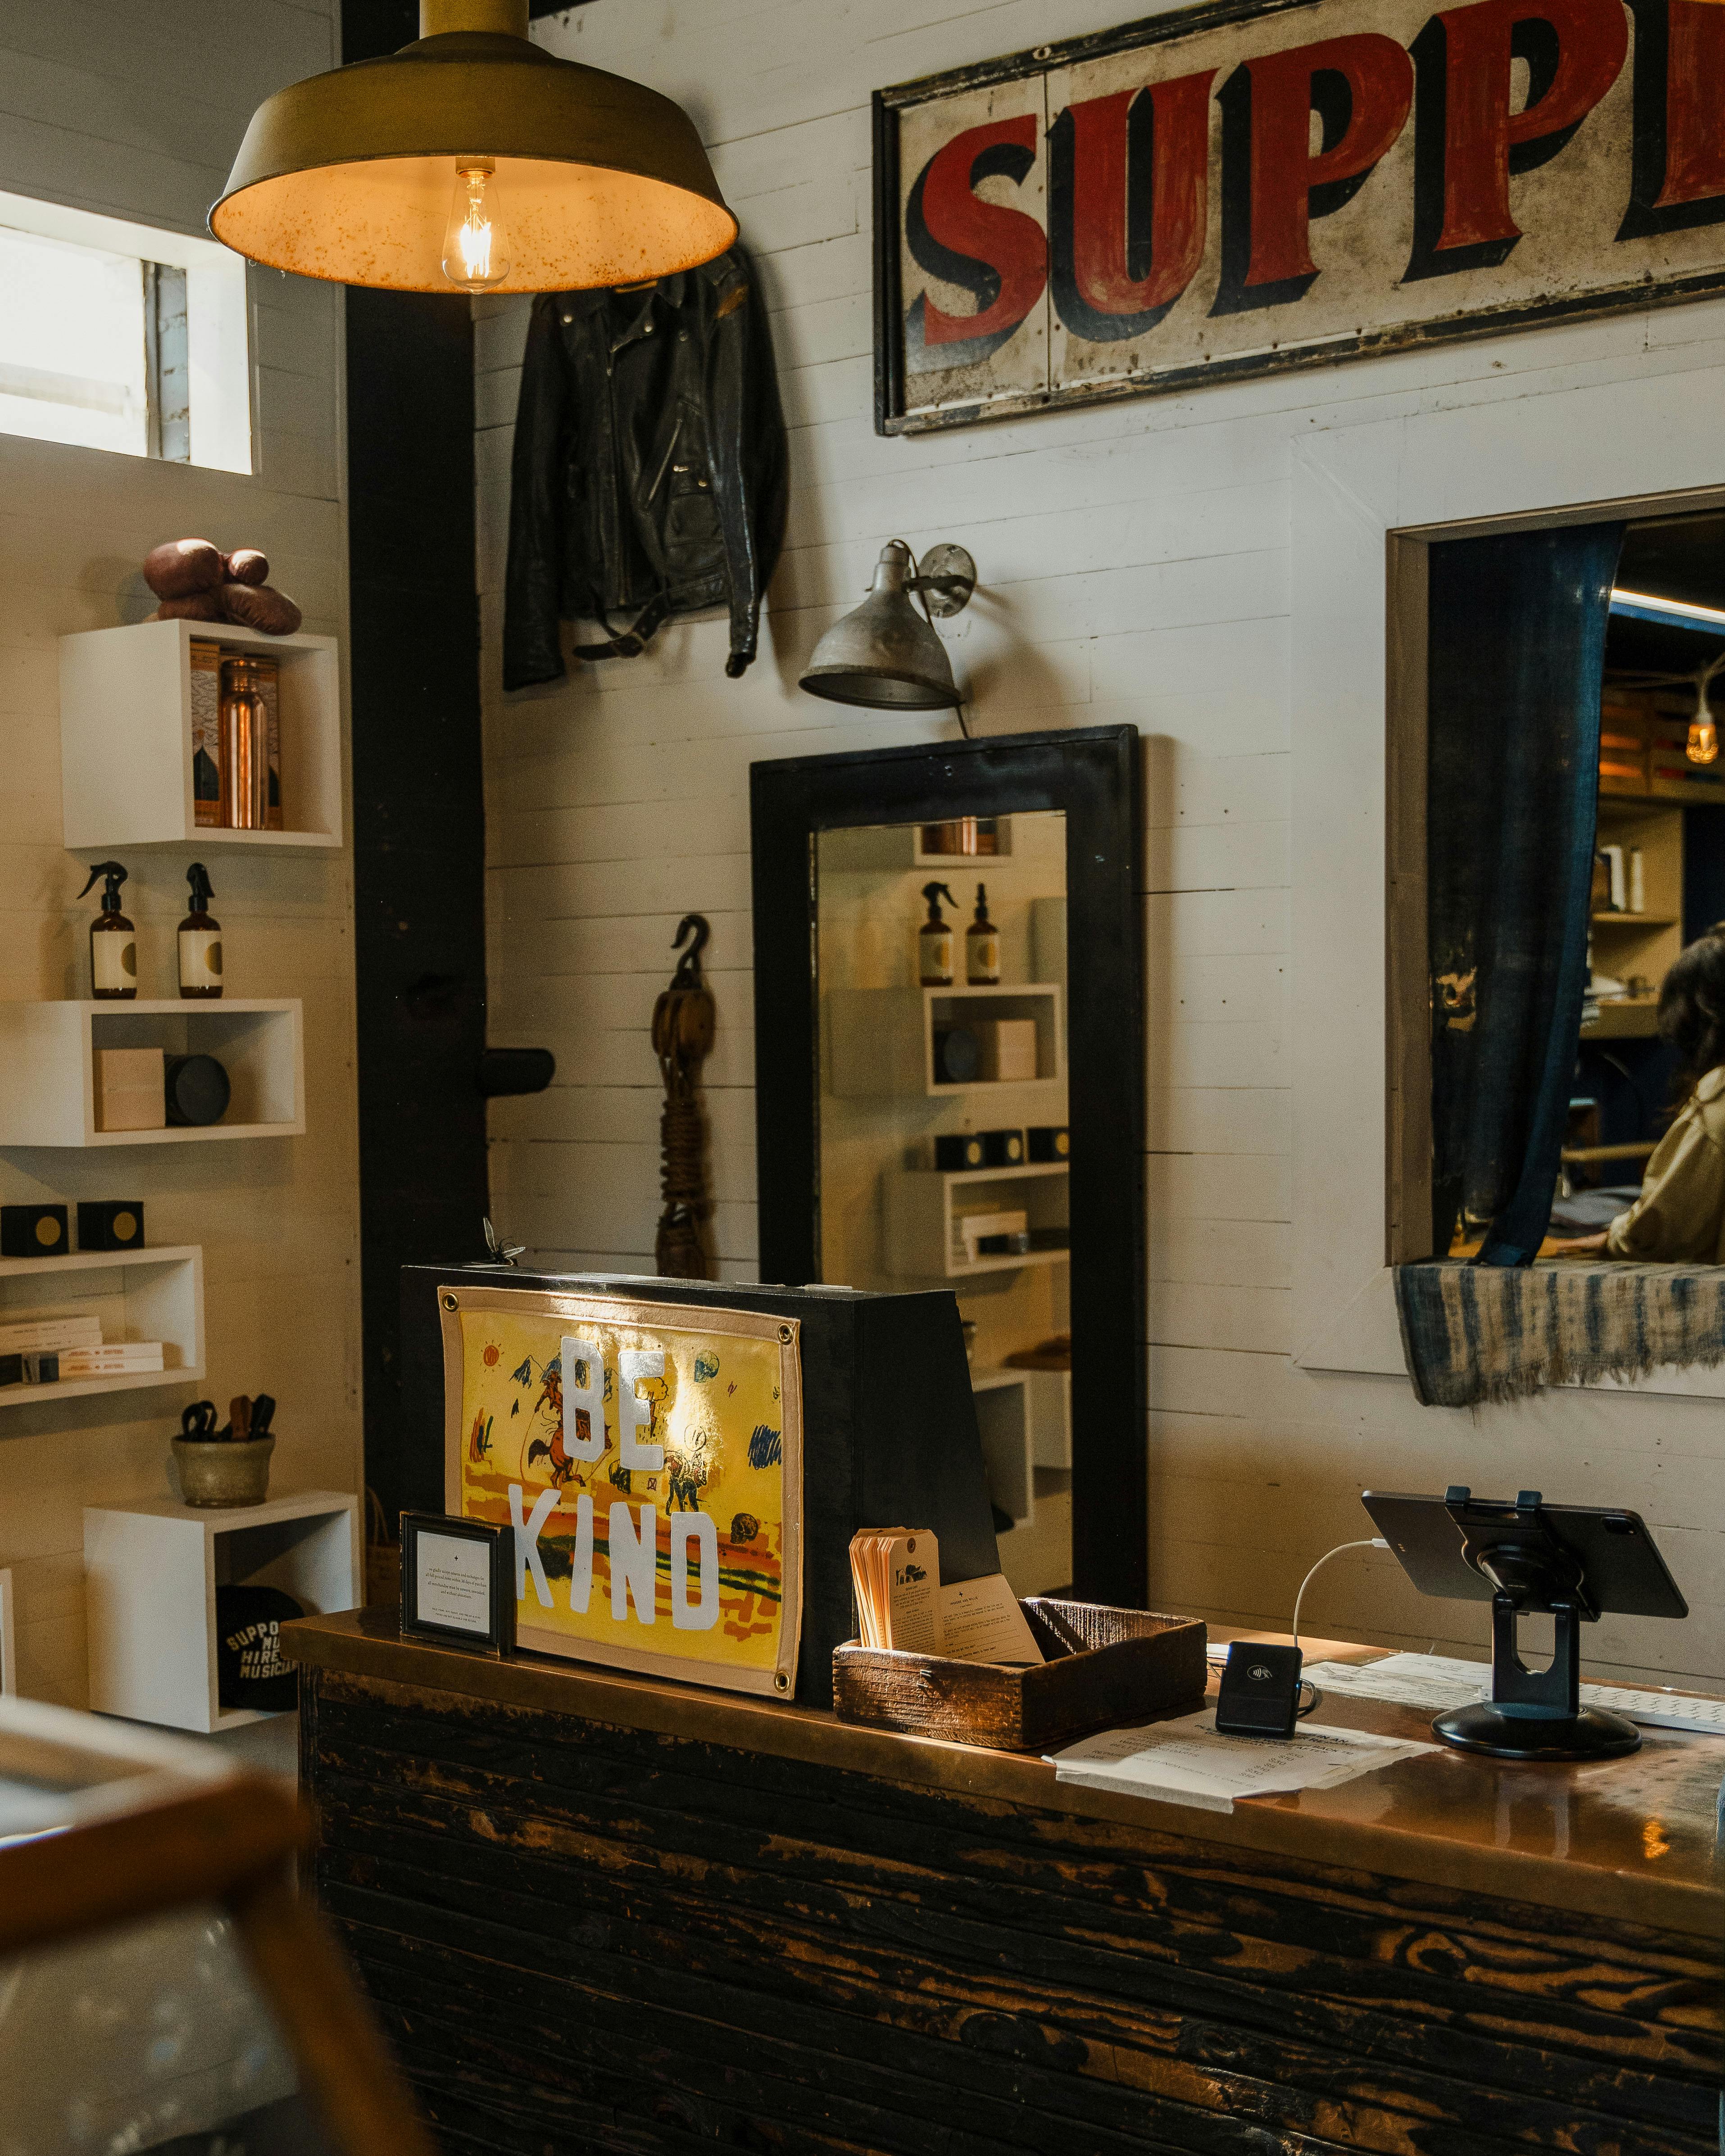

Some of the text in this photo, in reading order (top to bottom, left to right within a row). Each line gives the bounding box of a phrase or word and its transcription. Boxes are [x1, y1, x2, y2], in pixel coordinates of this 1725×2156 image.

[561, 1336, 665, 1471] BE
[508, 1483, 720, 1630] KIND
[227, 1621, 280, 1651] SUPPO
